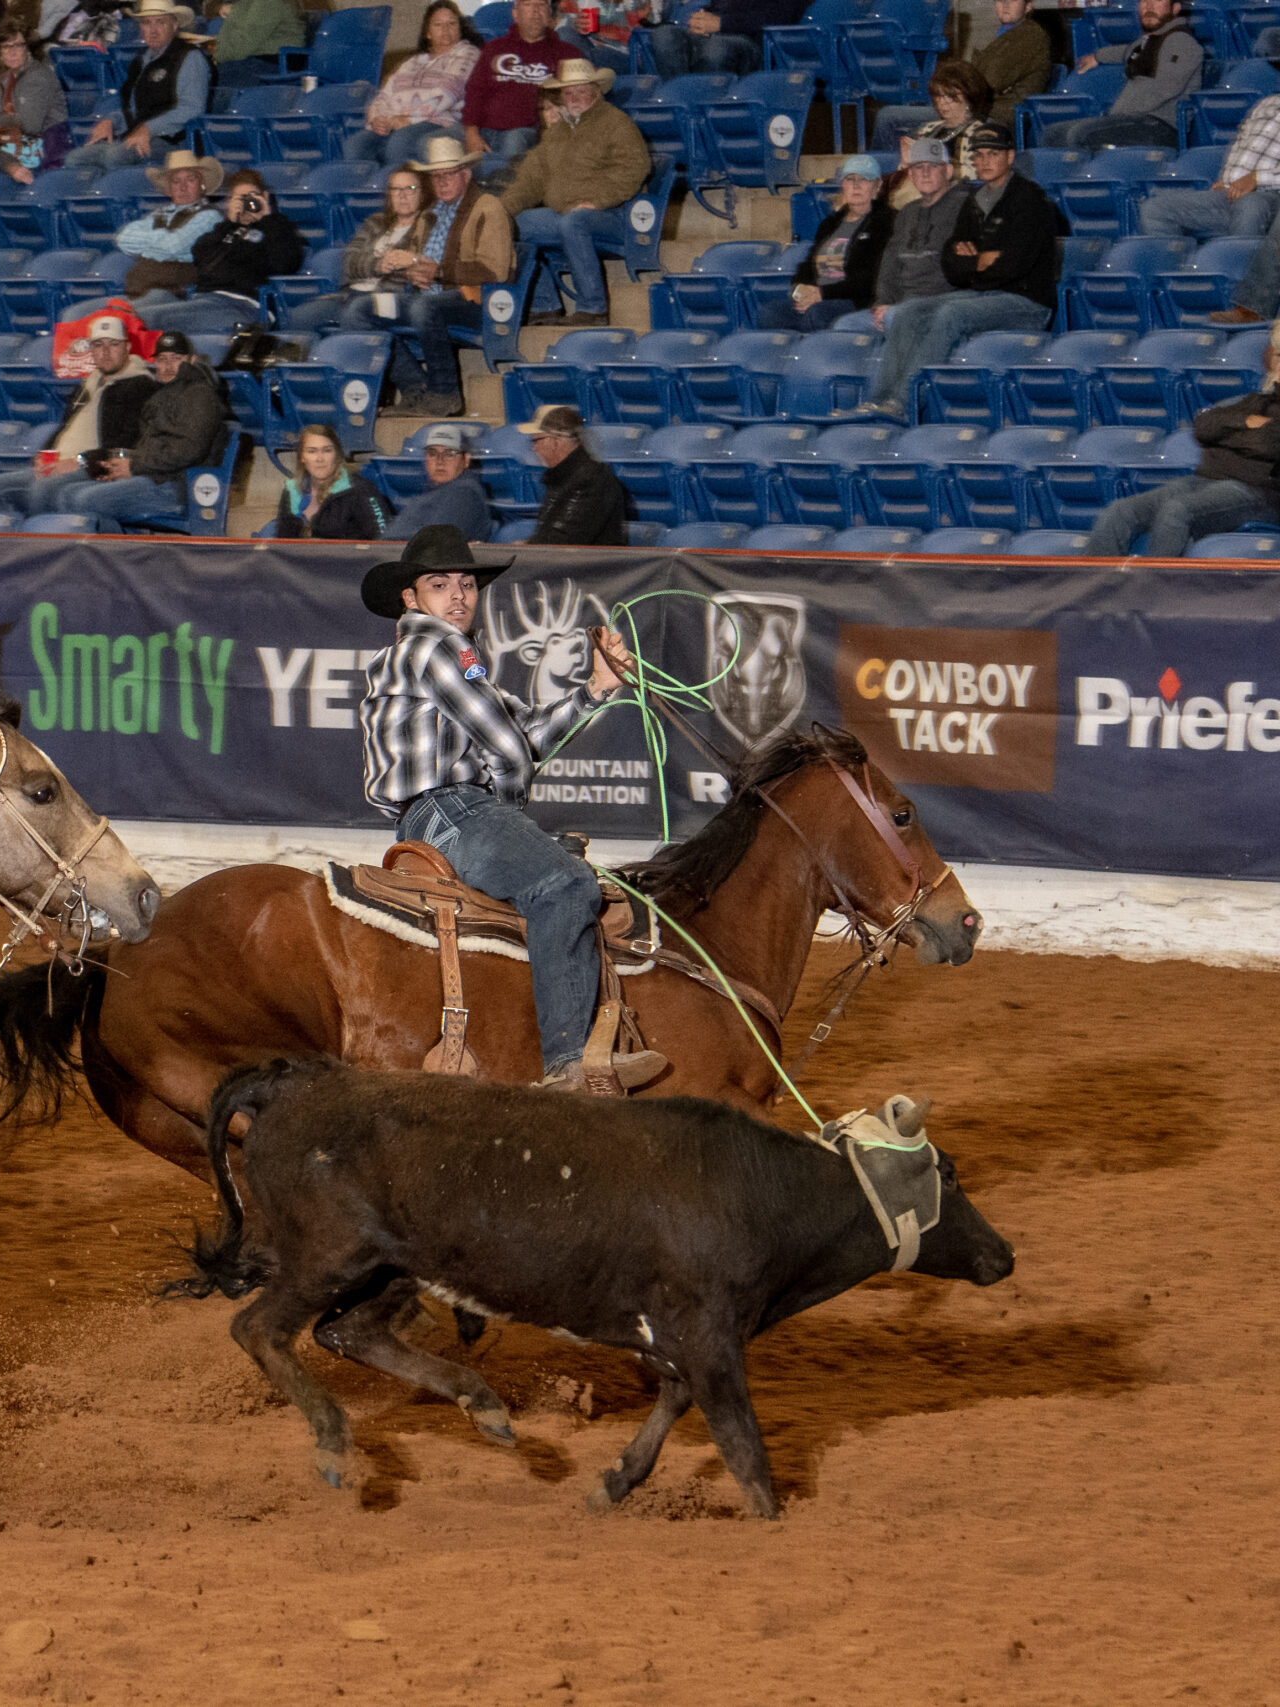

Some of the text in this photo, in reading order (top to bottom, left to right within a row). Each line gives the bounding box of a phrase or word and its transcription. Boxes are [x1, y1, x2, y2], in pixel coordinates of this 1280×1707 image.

[28, 602, 235, 755] Smarty
[255, 646, 380, 729] YE
[856, 658, 1035, 708] COWBOY
[888, 708, 1000, 756] TACK
[530, 783, 648, 805] UNDATION
